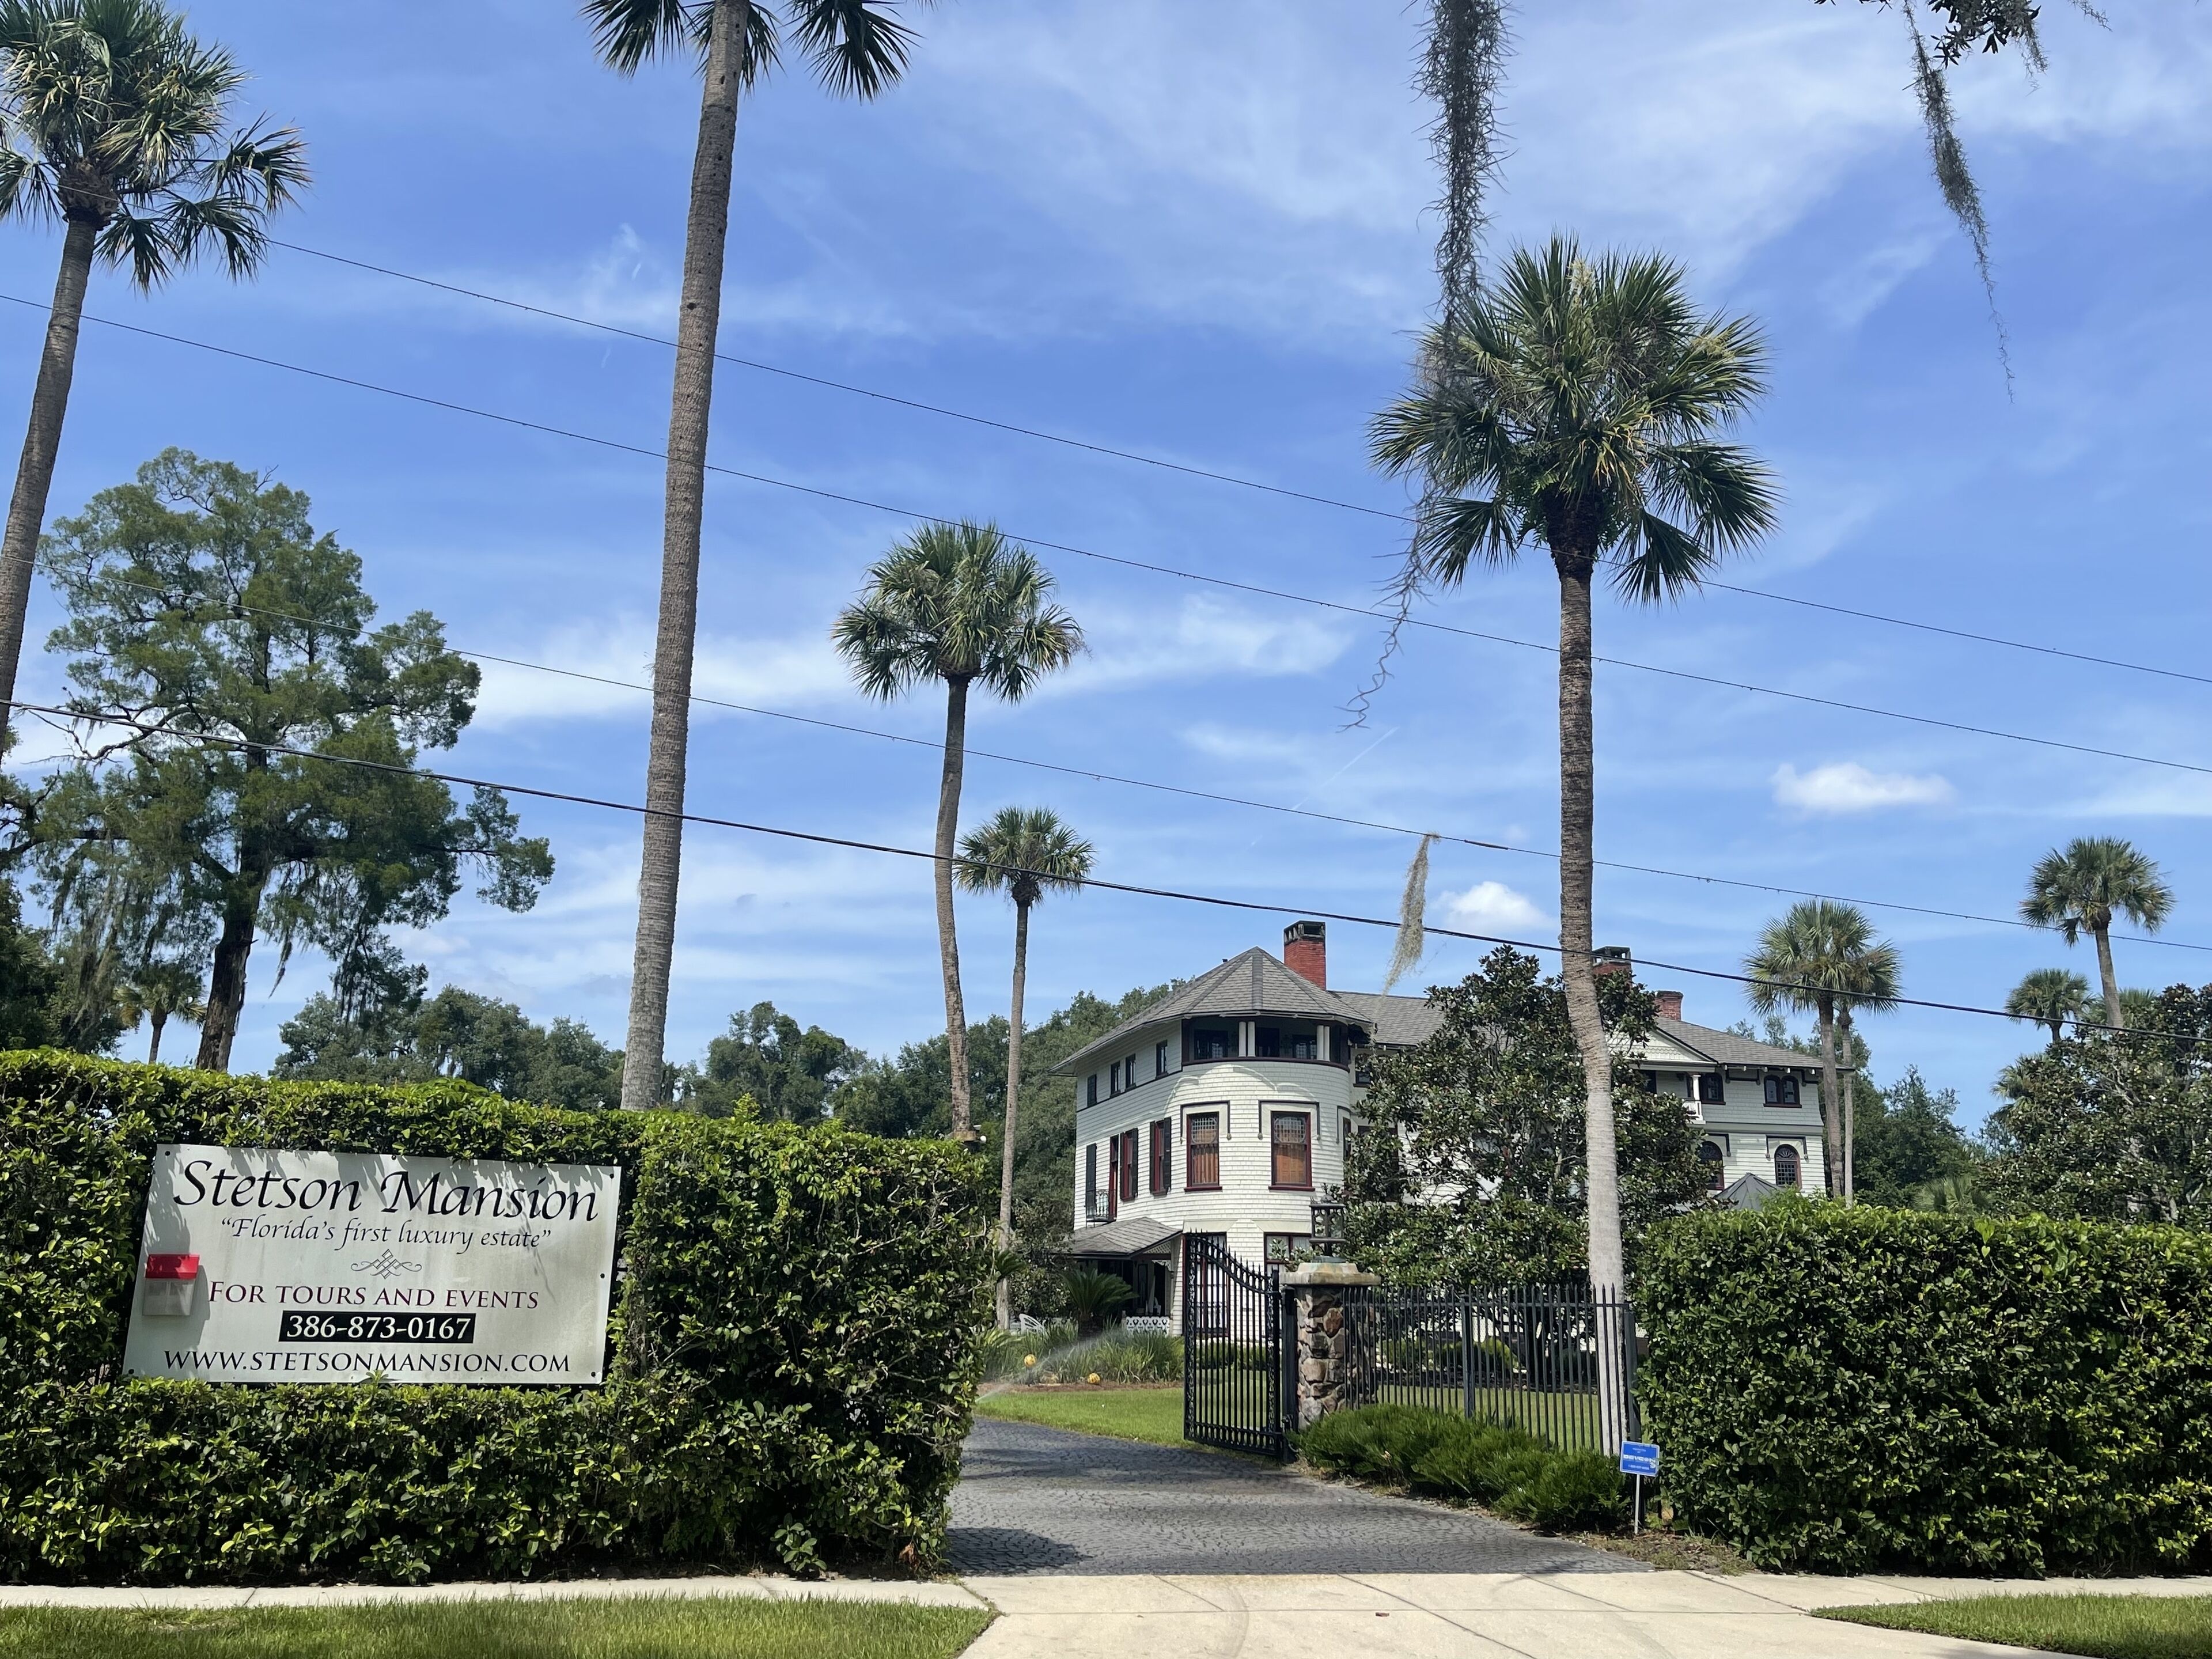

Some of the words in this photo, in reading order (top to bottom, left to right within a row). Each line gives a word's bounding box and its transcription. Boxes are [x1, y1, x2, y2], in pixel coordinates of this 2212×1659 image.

[173, 1160, 362, 1211] Stetson
[380, 1171, 599, 1221] Mansion
[335, 1217, 392, 1251] first
[399, 1219, 473, 1254] luxury
[480, 1229, 551, 1248] estate”
[209, 1281, 266, 1304] FOR
[275, 1285, 366, 1305] TOURS
[373, 1287, 435, 1306] AND
[445, 1290, 539, 1309] EVENTS
[286, 1315, 471, 1339] 386-873-0167
[164, 1350, 570, 1373] WWW.STETSONMANSION.COM
